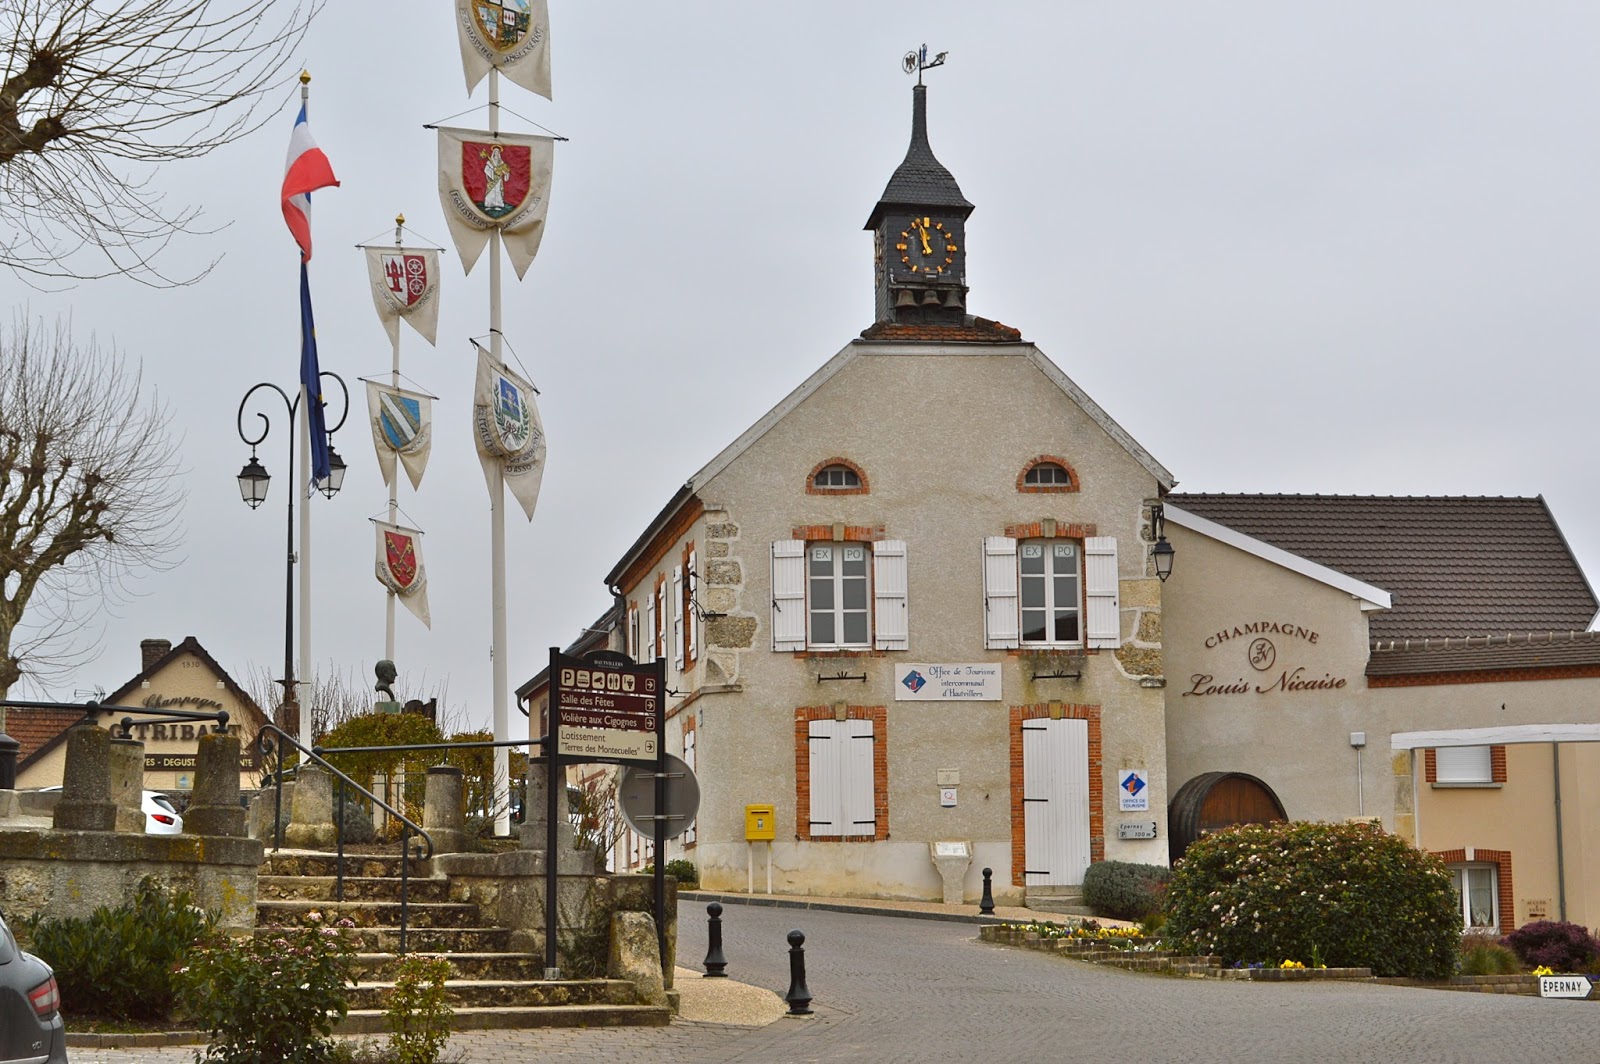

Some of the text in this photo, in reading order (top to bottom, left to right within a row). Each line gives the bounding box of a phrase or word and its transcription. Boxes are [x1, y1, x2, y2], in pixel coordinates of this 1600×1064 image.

[816, 550, 861, 559] EX PO
[1025, 546, 1072, 556] EX PO
[1204, 621, 1320, 649] CHAMPAGNE
[564, 671, 572, 684] P
[928, 666, 996, 679] Office de Tourisme
[940, 679, 985, 687] intercommunal
[1182, 667, 1348, 697] Louis Nicaise
[142, 693, 223, 710] Champagne
[561, 693, 615, 707] Salle des Fêtes
[560, 712, 587, 724] Volière
[604, 715, 637, 728] Cigognes
[561, 730, 606, 742] Lotissement
[585, 744, 596, 753] des
[1543, 979, 1582, 993] ÉPERNAY
